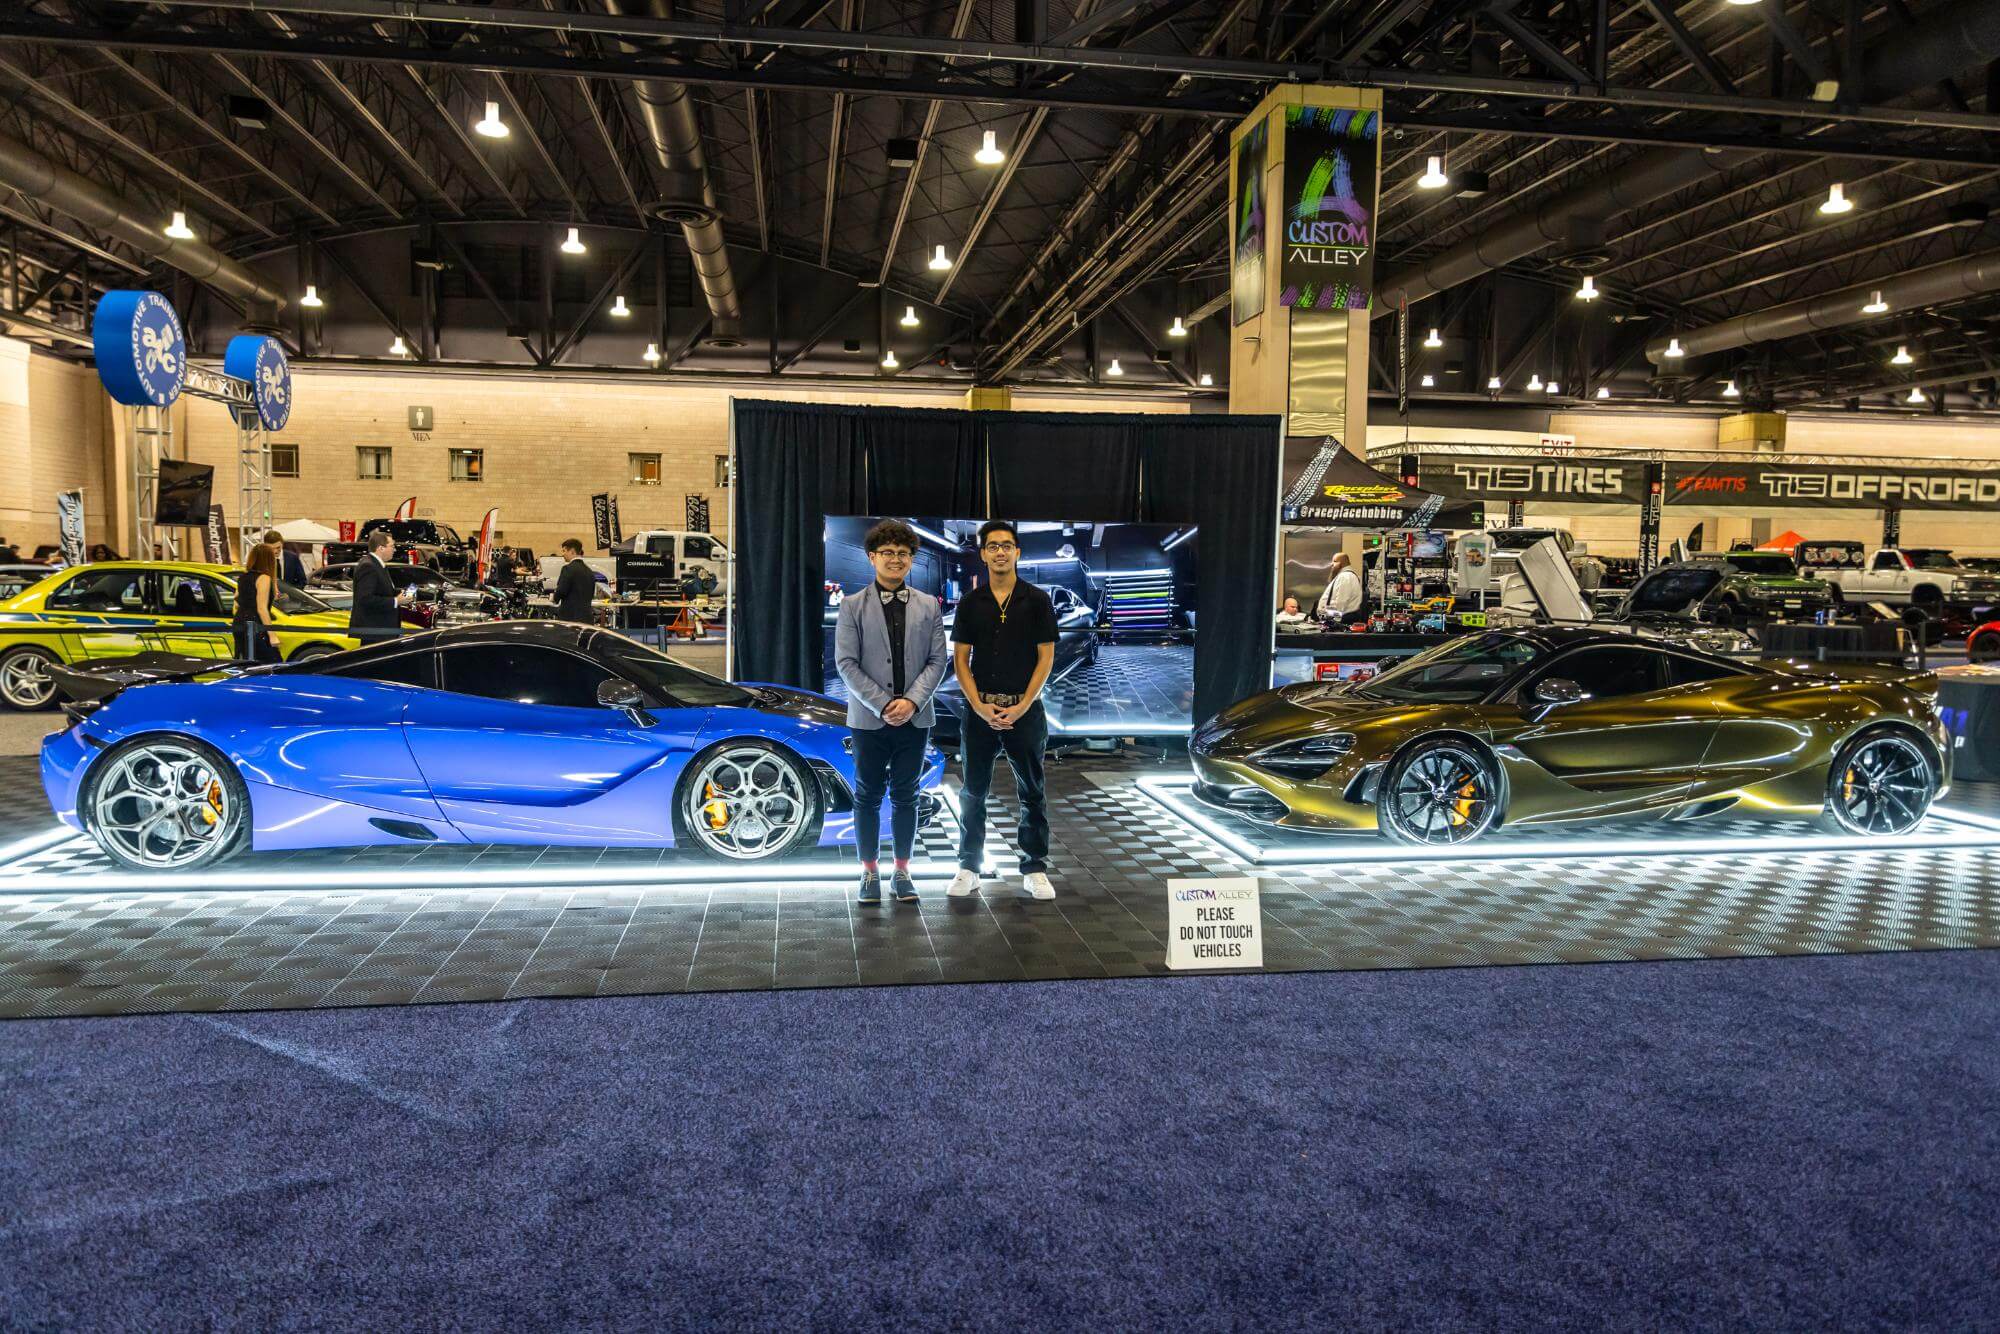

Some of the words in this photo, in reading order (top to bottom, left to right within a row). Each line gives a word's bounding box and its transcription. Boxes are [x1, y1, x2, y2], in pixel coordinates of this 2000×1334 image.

[1289, 220, 1368, 246] CUSTOM
[1289, 247, 1367, 265] ALLEY
[132, 301, 155, 396] AUTOMOTIVE
[148, 294, 183, 341] TRAINING
[169, 351, 185, 400] CENTER
[1541, 439, 1572, 456] EXIT
[1537, 465, 1623, 495] TIRES
[1830, 474, 2000, 502] OFFROAD
[1300, 505, 1403, 520] @raceplacehobbies
[1175, 888, 1217, 902] CUSTOM
[1218, 890, 1254, 900] ALLEY
[1197, 907, 1235, 921] PLEASE
[1180, 926, 1194, 940] DO
[1197, 925, 1218, 939] NOT
[1220, 925, 1253, 939] TOUCH
[1193, 943, 1242, 958] VEHICLES
